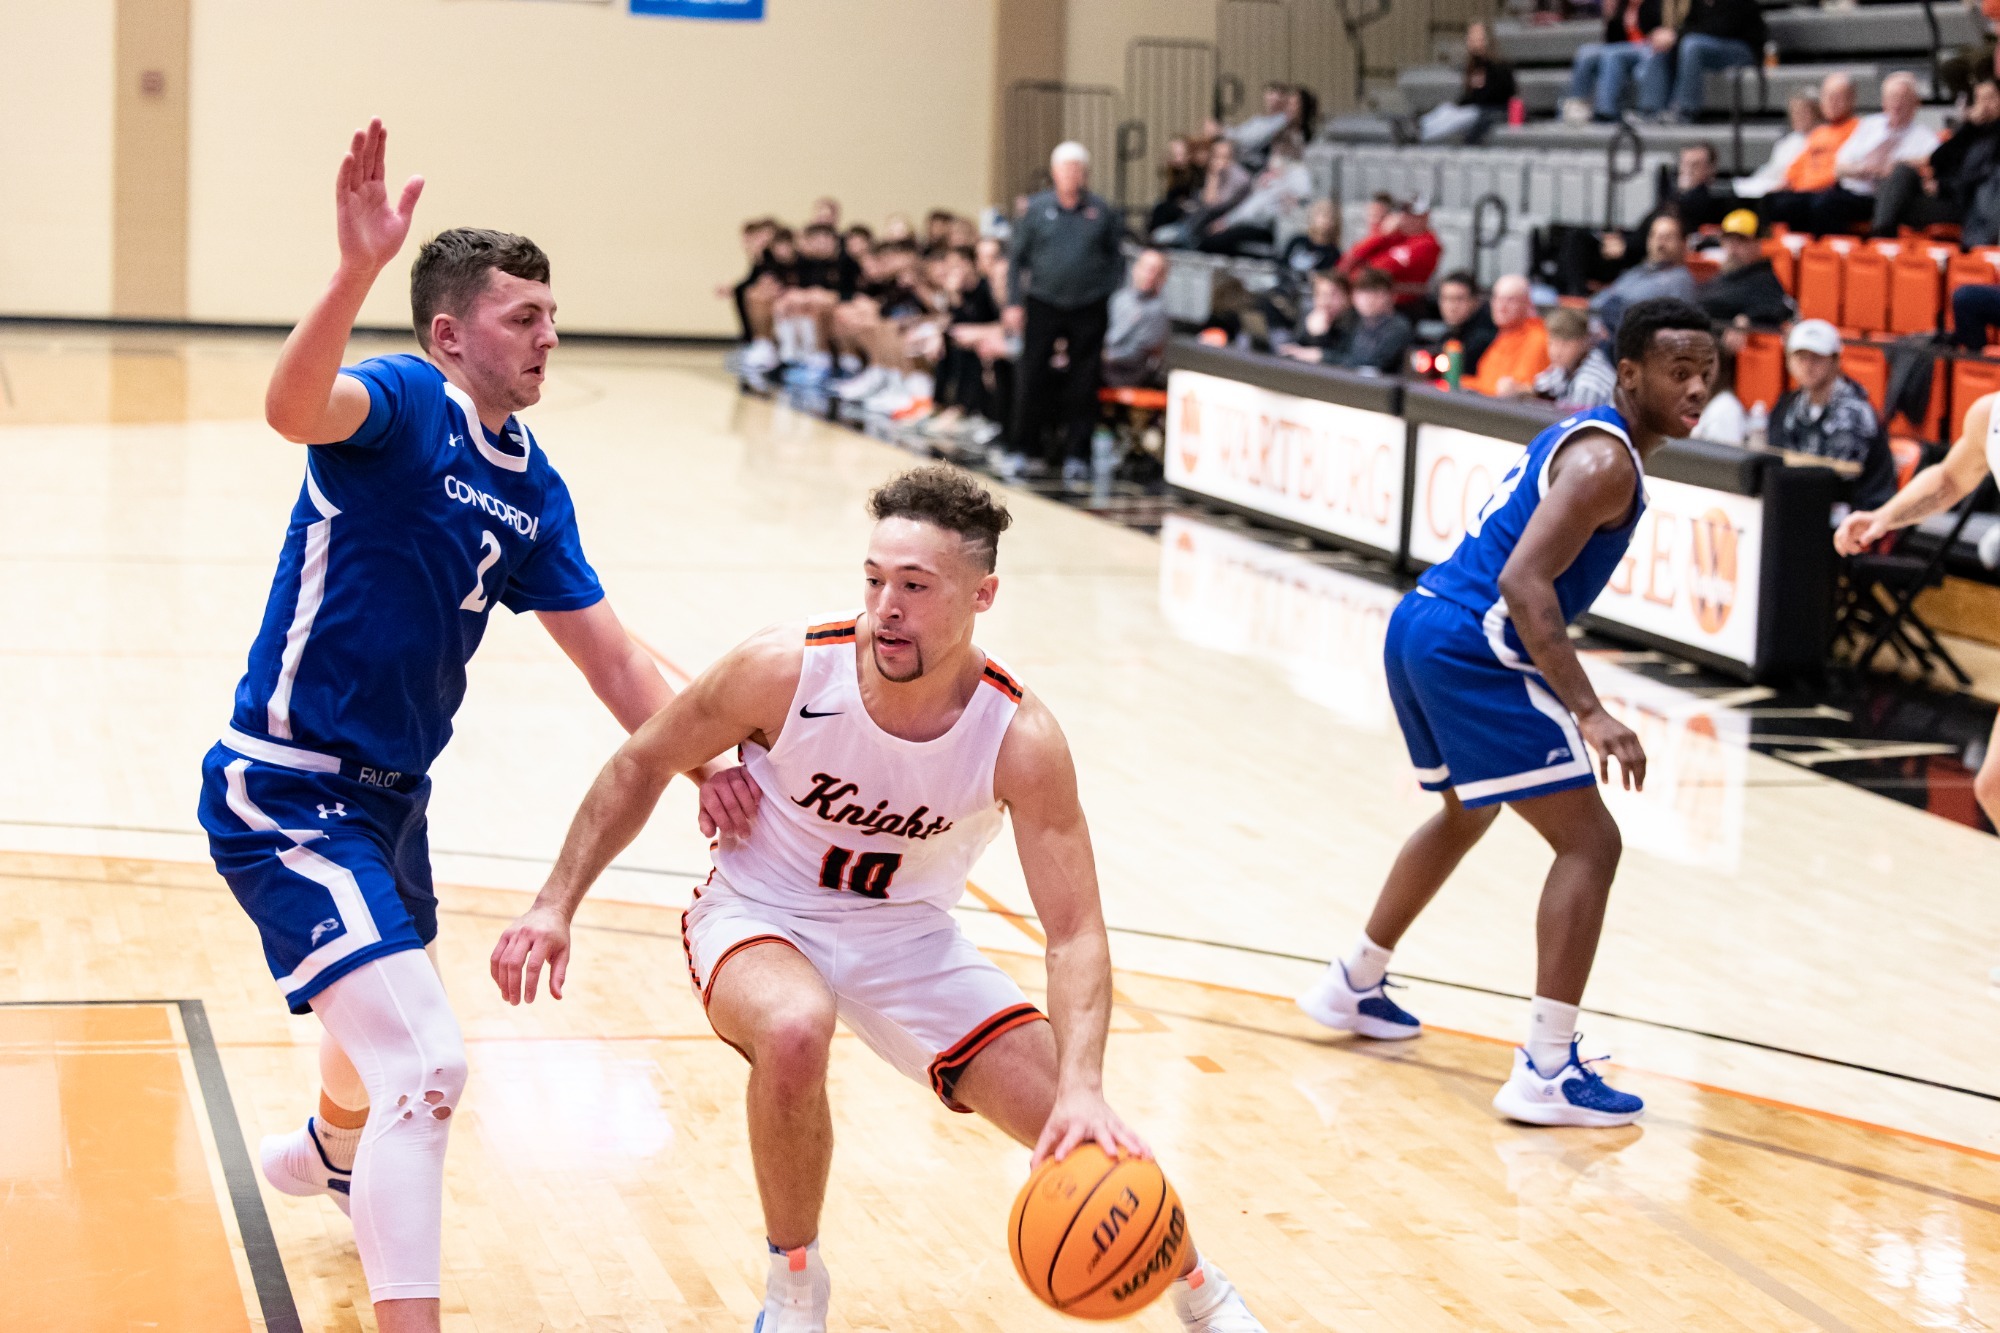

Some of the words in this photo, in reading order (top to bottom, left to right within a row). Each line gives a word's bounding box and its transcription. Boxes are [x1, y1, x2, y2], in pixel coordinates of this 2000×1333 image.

[444, 475, 540, 542] CONCORDI
[459, 530, 502, 613] 2
[819, 845, 903, 899] 10
